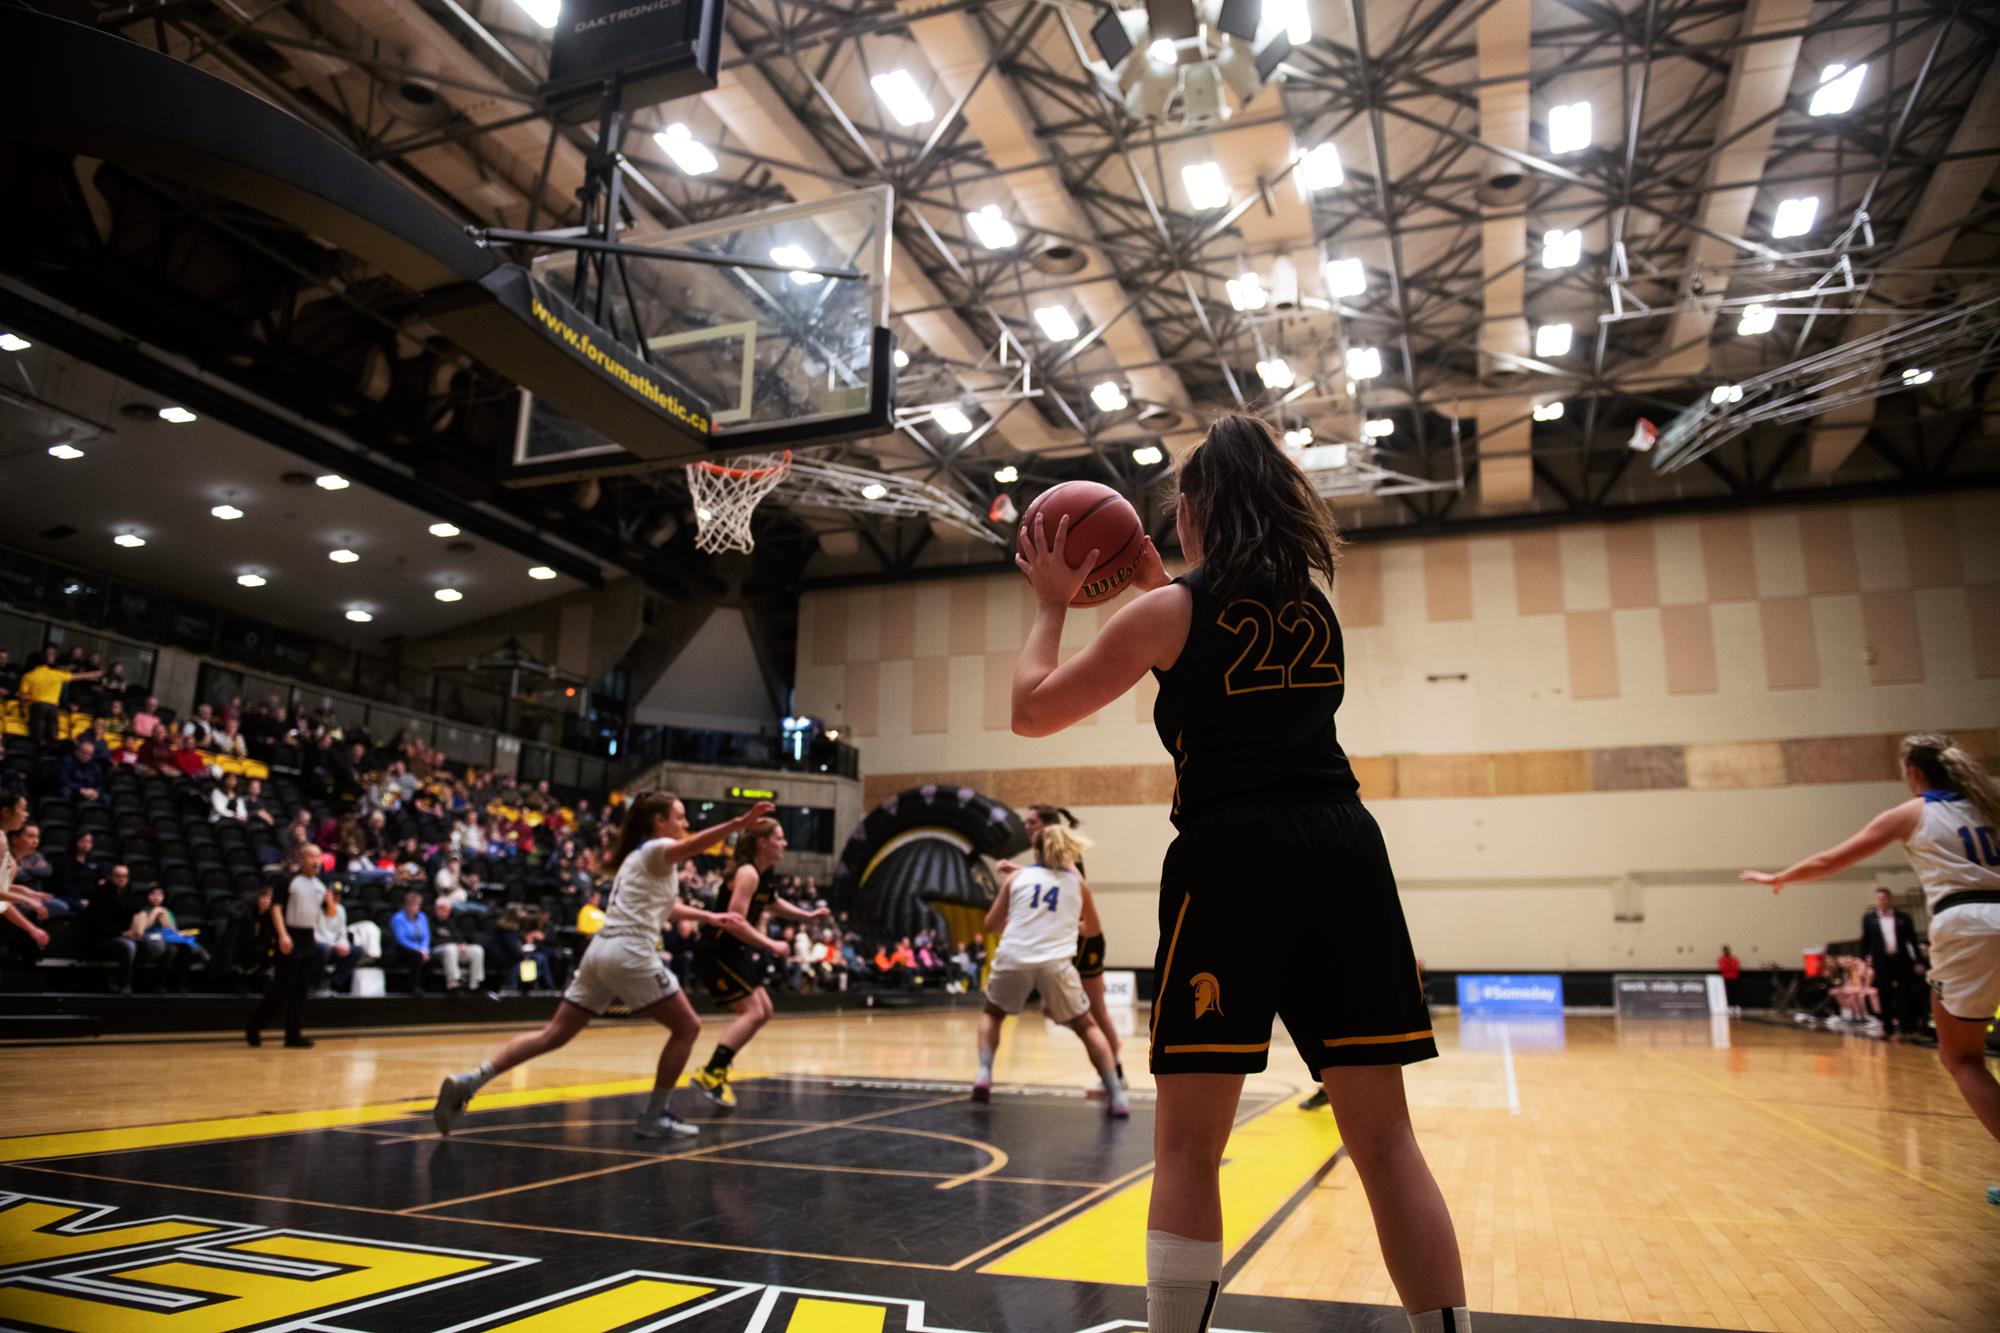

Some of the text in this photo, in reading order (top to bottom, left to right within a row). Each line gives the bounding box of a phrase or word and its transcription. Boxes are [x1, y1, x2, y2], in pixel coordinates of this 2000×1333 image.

[531, 297, 709, 433] www.forumathletic.ca
[1216, 599, 1344, 695] 22
[1958, 825, 2000, 866] 10
[1030, 883, 1060, 912] 14
